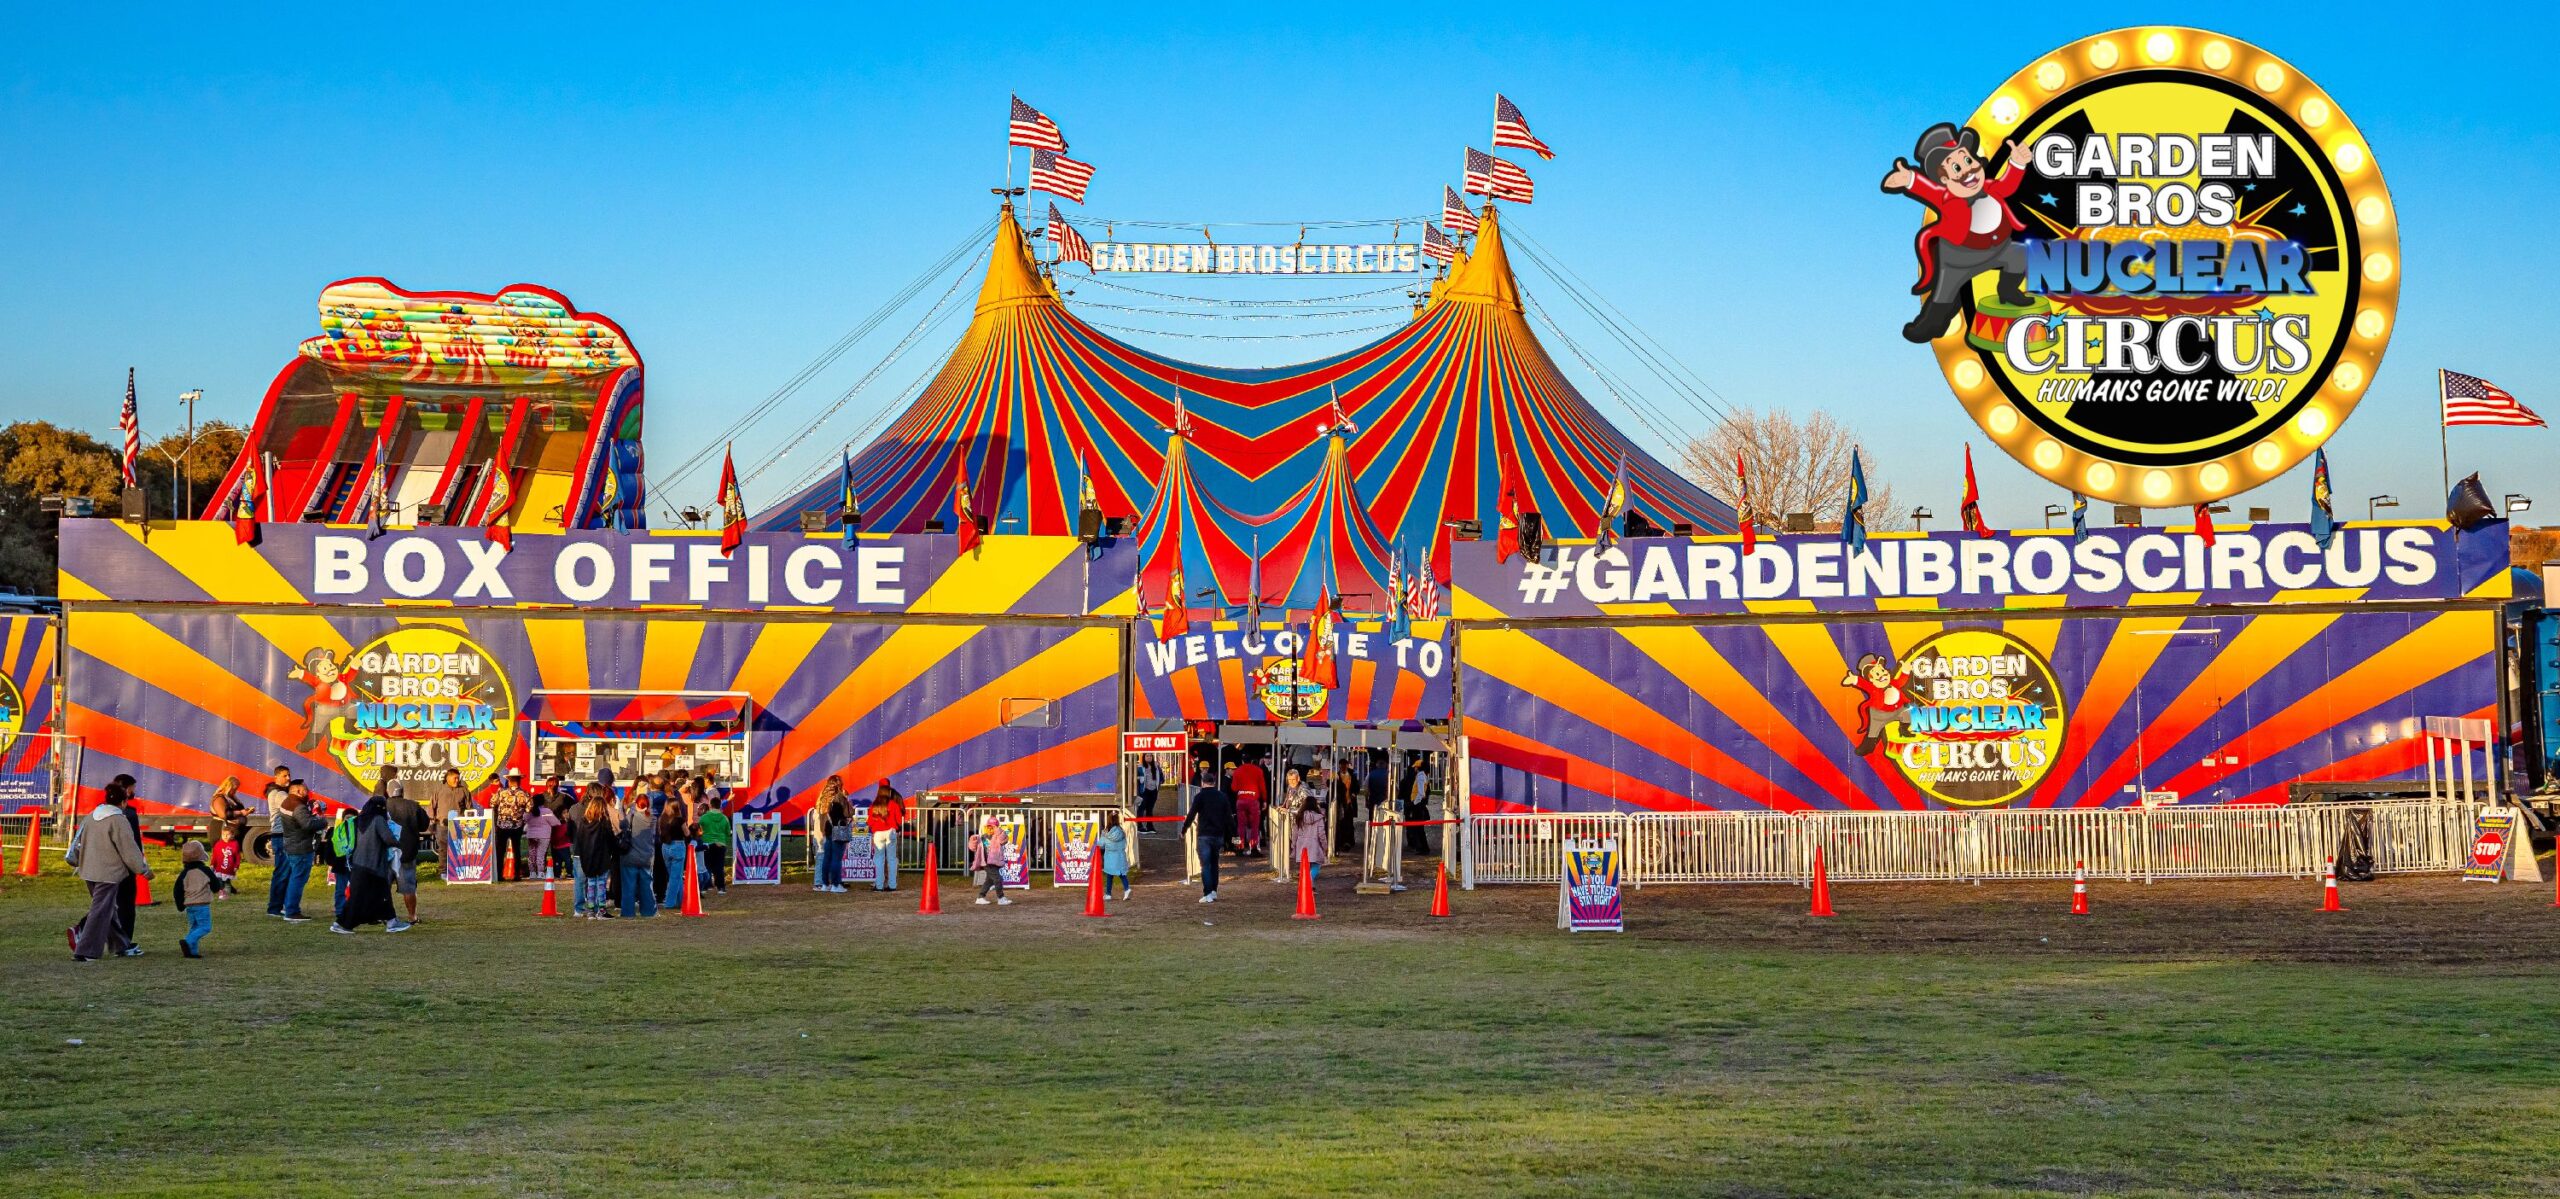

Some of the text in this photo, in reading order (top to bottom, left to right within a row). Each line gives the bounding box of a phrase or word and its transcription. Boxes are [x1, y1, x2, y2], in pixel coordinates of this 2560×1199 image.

[313, 536, 905, 604] BOX OFFICE
[1516, 527, 2438, 604] #GARDENBROSCIRCUS
[361, 652, 480, 675] GARDEN
[1145, 631, 1443, 677] WELCOE TO
[1912, 654, 2027, 678] GARDEN
[381, 676, 460, 697] BROS
[1933, 677, 2009, 700] BROS
[356, 703, 497, 730] NUCLEAR
[1909, 704, 2047, 731] NUCLEAR
[346, 738, 495, 767] CIRCUS
[1133, 737, 1176, 749] EXIT ONLY
[1902, 740, 2046, 769] CIRCUS
[361, 769, 413, 781] HUNS
[414, 769, 445, 781] GONE
[1918, 768, 2035, 782] HUMANS GONE WILD!
[2476, 842, 2501, 856] STOP
[842, 859, 875, 868] DMISSIO
[845, 868, 874, 878] TICKETS
[1581, 874, 1606, 885] IF YOU
[1571, 885, 1617, 897] HAVE TICKETS
[1578, 895, 1612, 907] STAY RIGHT
